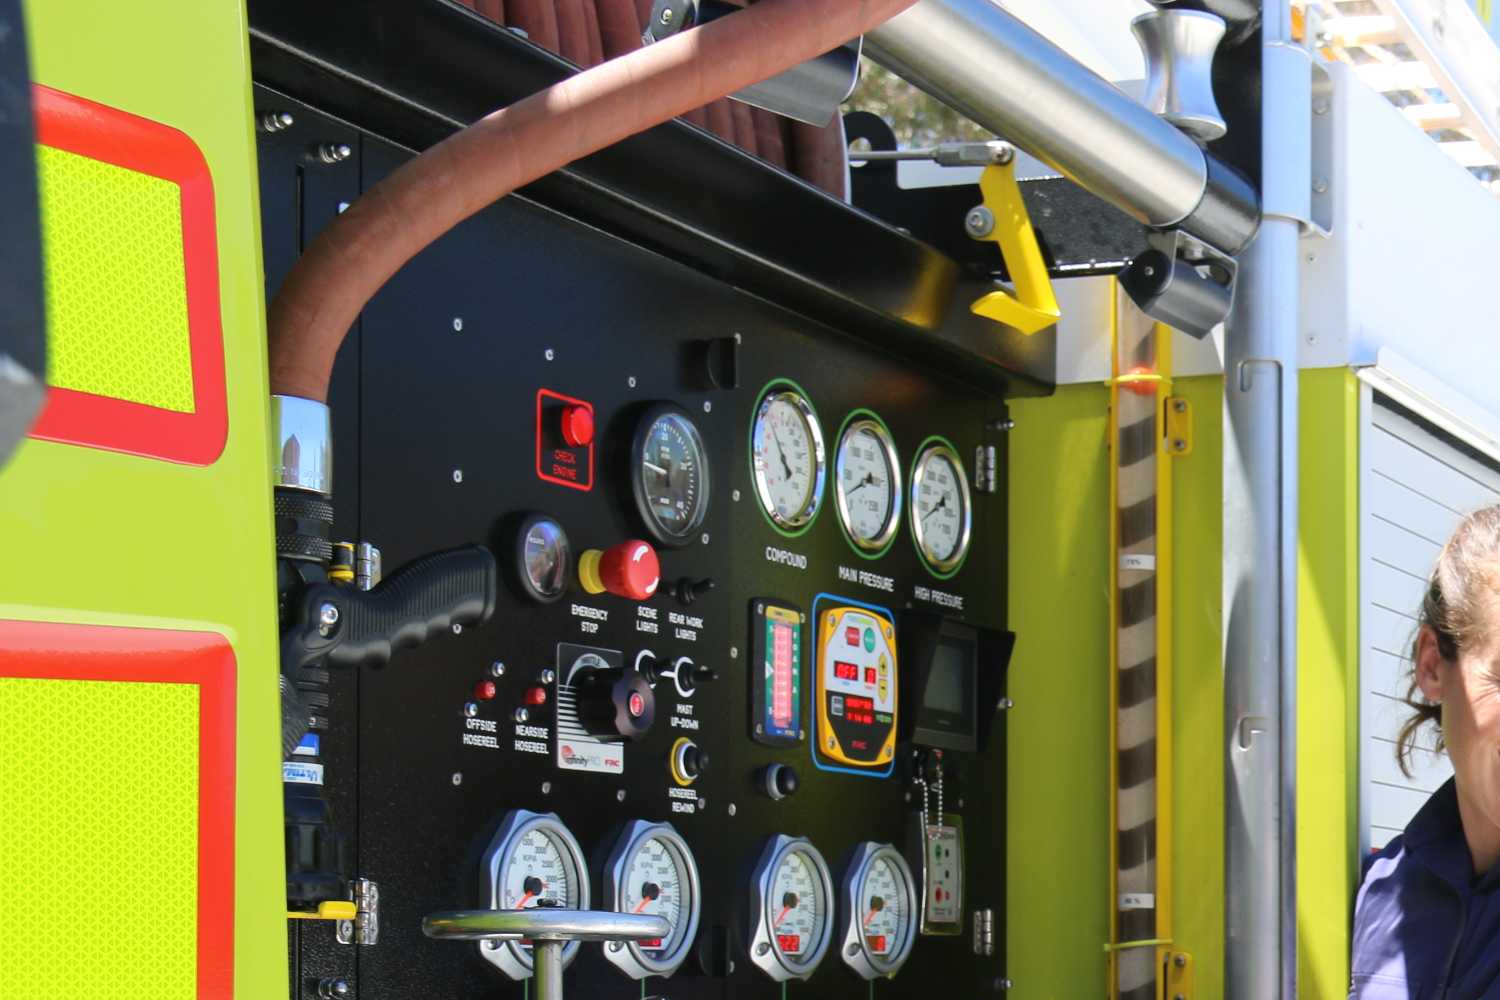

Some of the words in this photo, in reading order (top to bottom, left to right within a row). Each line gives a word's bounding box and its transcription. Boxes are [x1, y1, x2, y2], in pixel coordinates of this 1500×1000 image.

[765, 546, 808, 570] COMPOUND
[838, 565, 858, 583] MAIN
[859, 572, 895, 593] PRESSURE
[914, 586, 930, 600] HIGH
[931, 590, 964, 610] PRESSURE
[571, 603, 608, 621] EMERGENCY
[637, 605, 658, 620] SCENE
[668, 611, 685, 624] REAR
[686, 615, 703, 628] WORK
[581, 621, 599, 633] STOP
[636, 620, 658, 634] LIGHTS
[675, 628, 697, 641] LIGHTS
[676, 703, 693, 716] MAST
[466, 718, 497, 732] OFFSIDE
[671, 716, 699, 730] UP-DOWN
[515, 724, 549, 739] NEARSIDE
[463, 733, 500, 749] HOSEREEL
[514, 739, 549, 754] HOSEREEL
[668, 787, 698, 800] HOSEREEL
[672, 801, 695, 814] REWIND
